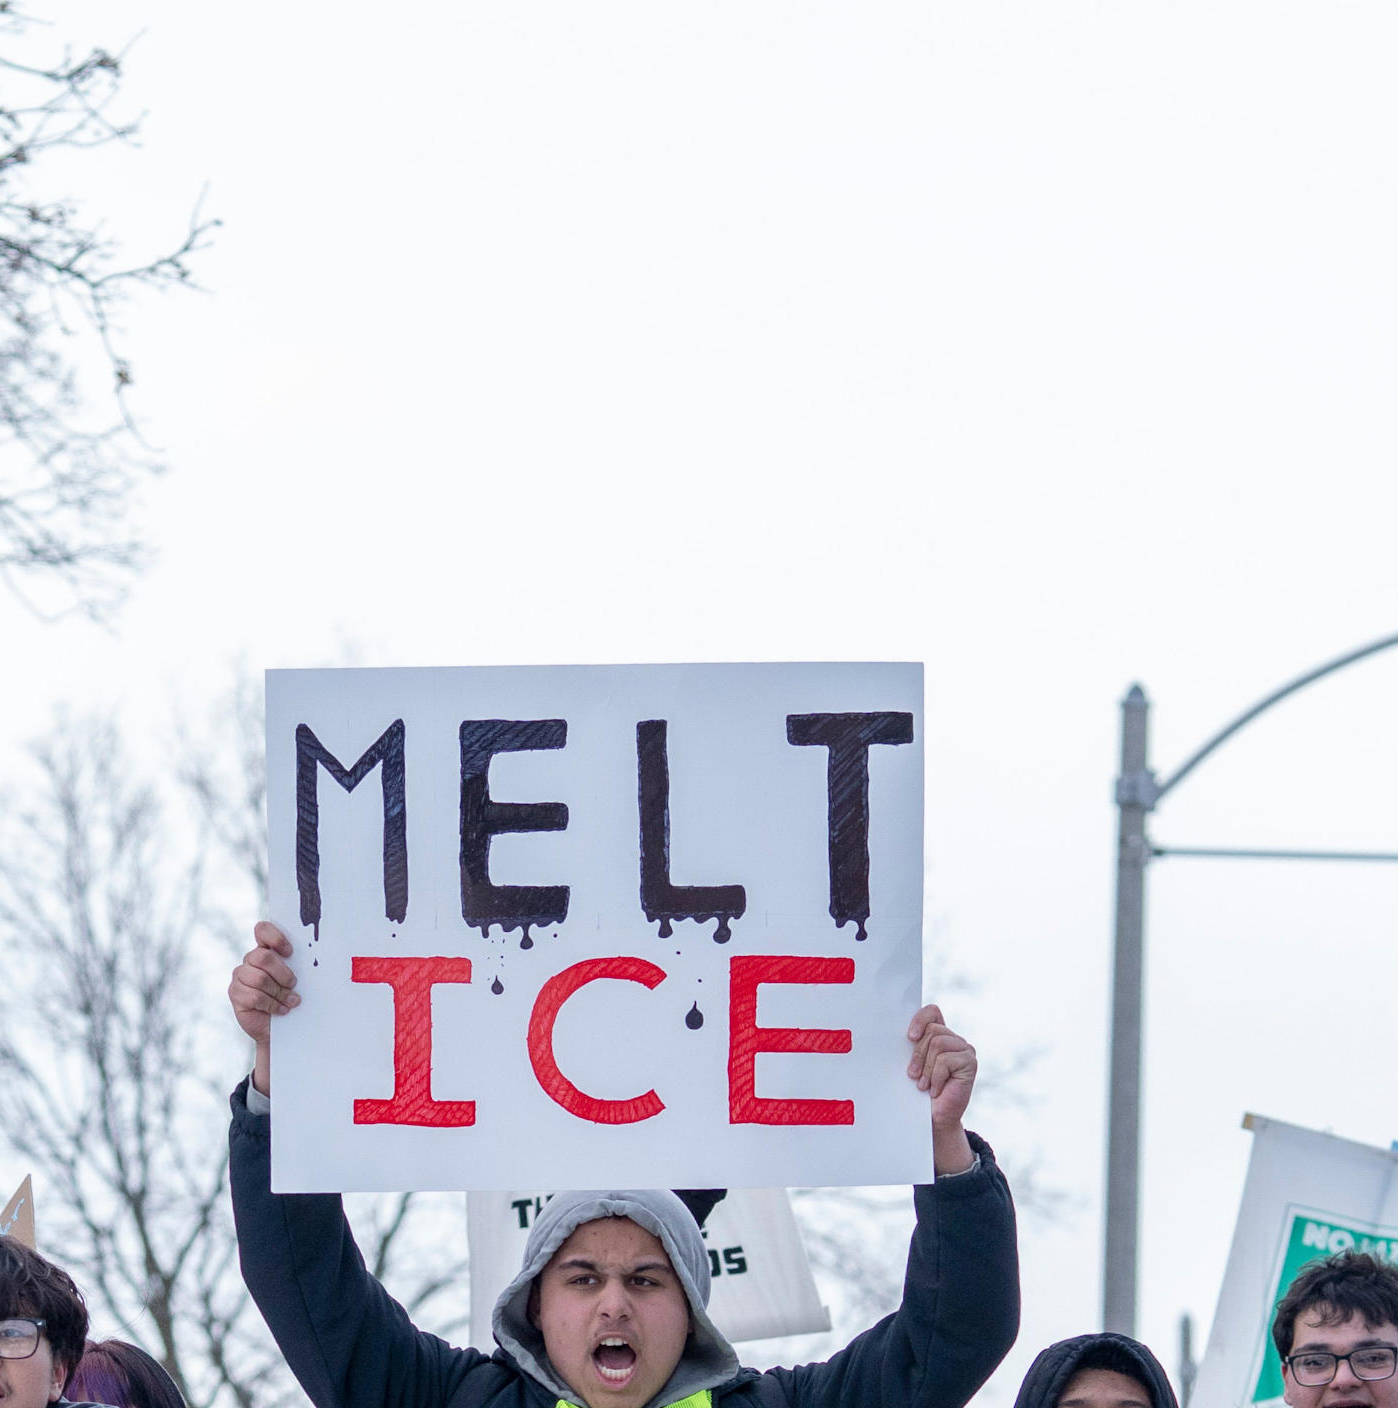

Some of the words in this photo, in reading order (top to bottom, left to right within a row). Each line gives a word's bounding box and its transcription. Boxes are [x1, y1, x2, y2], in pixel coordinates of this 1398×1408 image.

[294, 711, 914, 940] MELT
[351, 955, 856, 1128] ICE
[1302, 1222, 1355, 1255] NO
